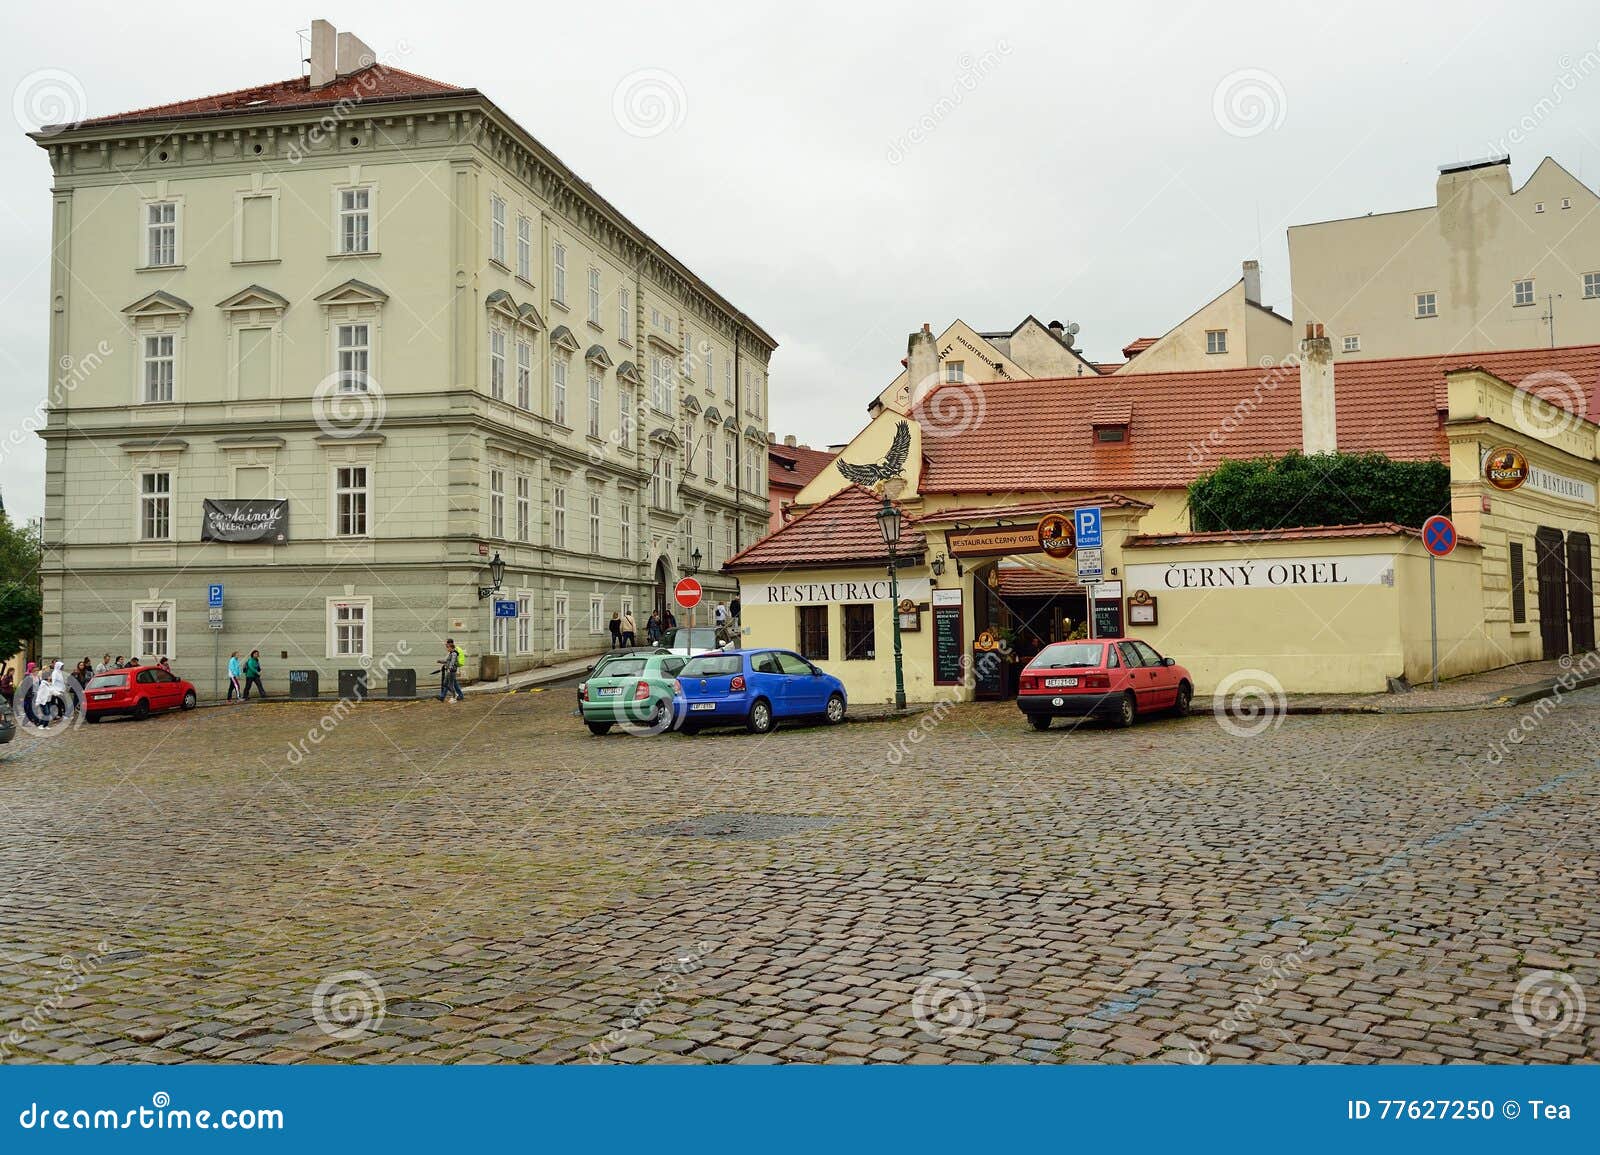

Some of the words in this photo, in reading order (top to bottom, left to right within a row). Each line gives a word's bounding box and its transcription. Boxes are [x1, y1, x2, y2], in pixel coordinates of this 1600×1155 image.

[1490, 469, 1522, 480] Kozel
[1543, 474, 1584, 498] RESTAURACE
[1080, 512, 1095, 535] P
[952, 537, 993, 547] RESTAURACE
[994, 534, 1018, 545] ČERNÝ
[1019, 534, 1036, 543] OREL
[1042, 538, 1073, 549] Kozel
[1164, 560, 1255, 588] ČERNÝ
[1267, 562, 1348, 585] OREL
